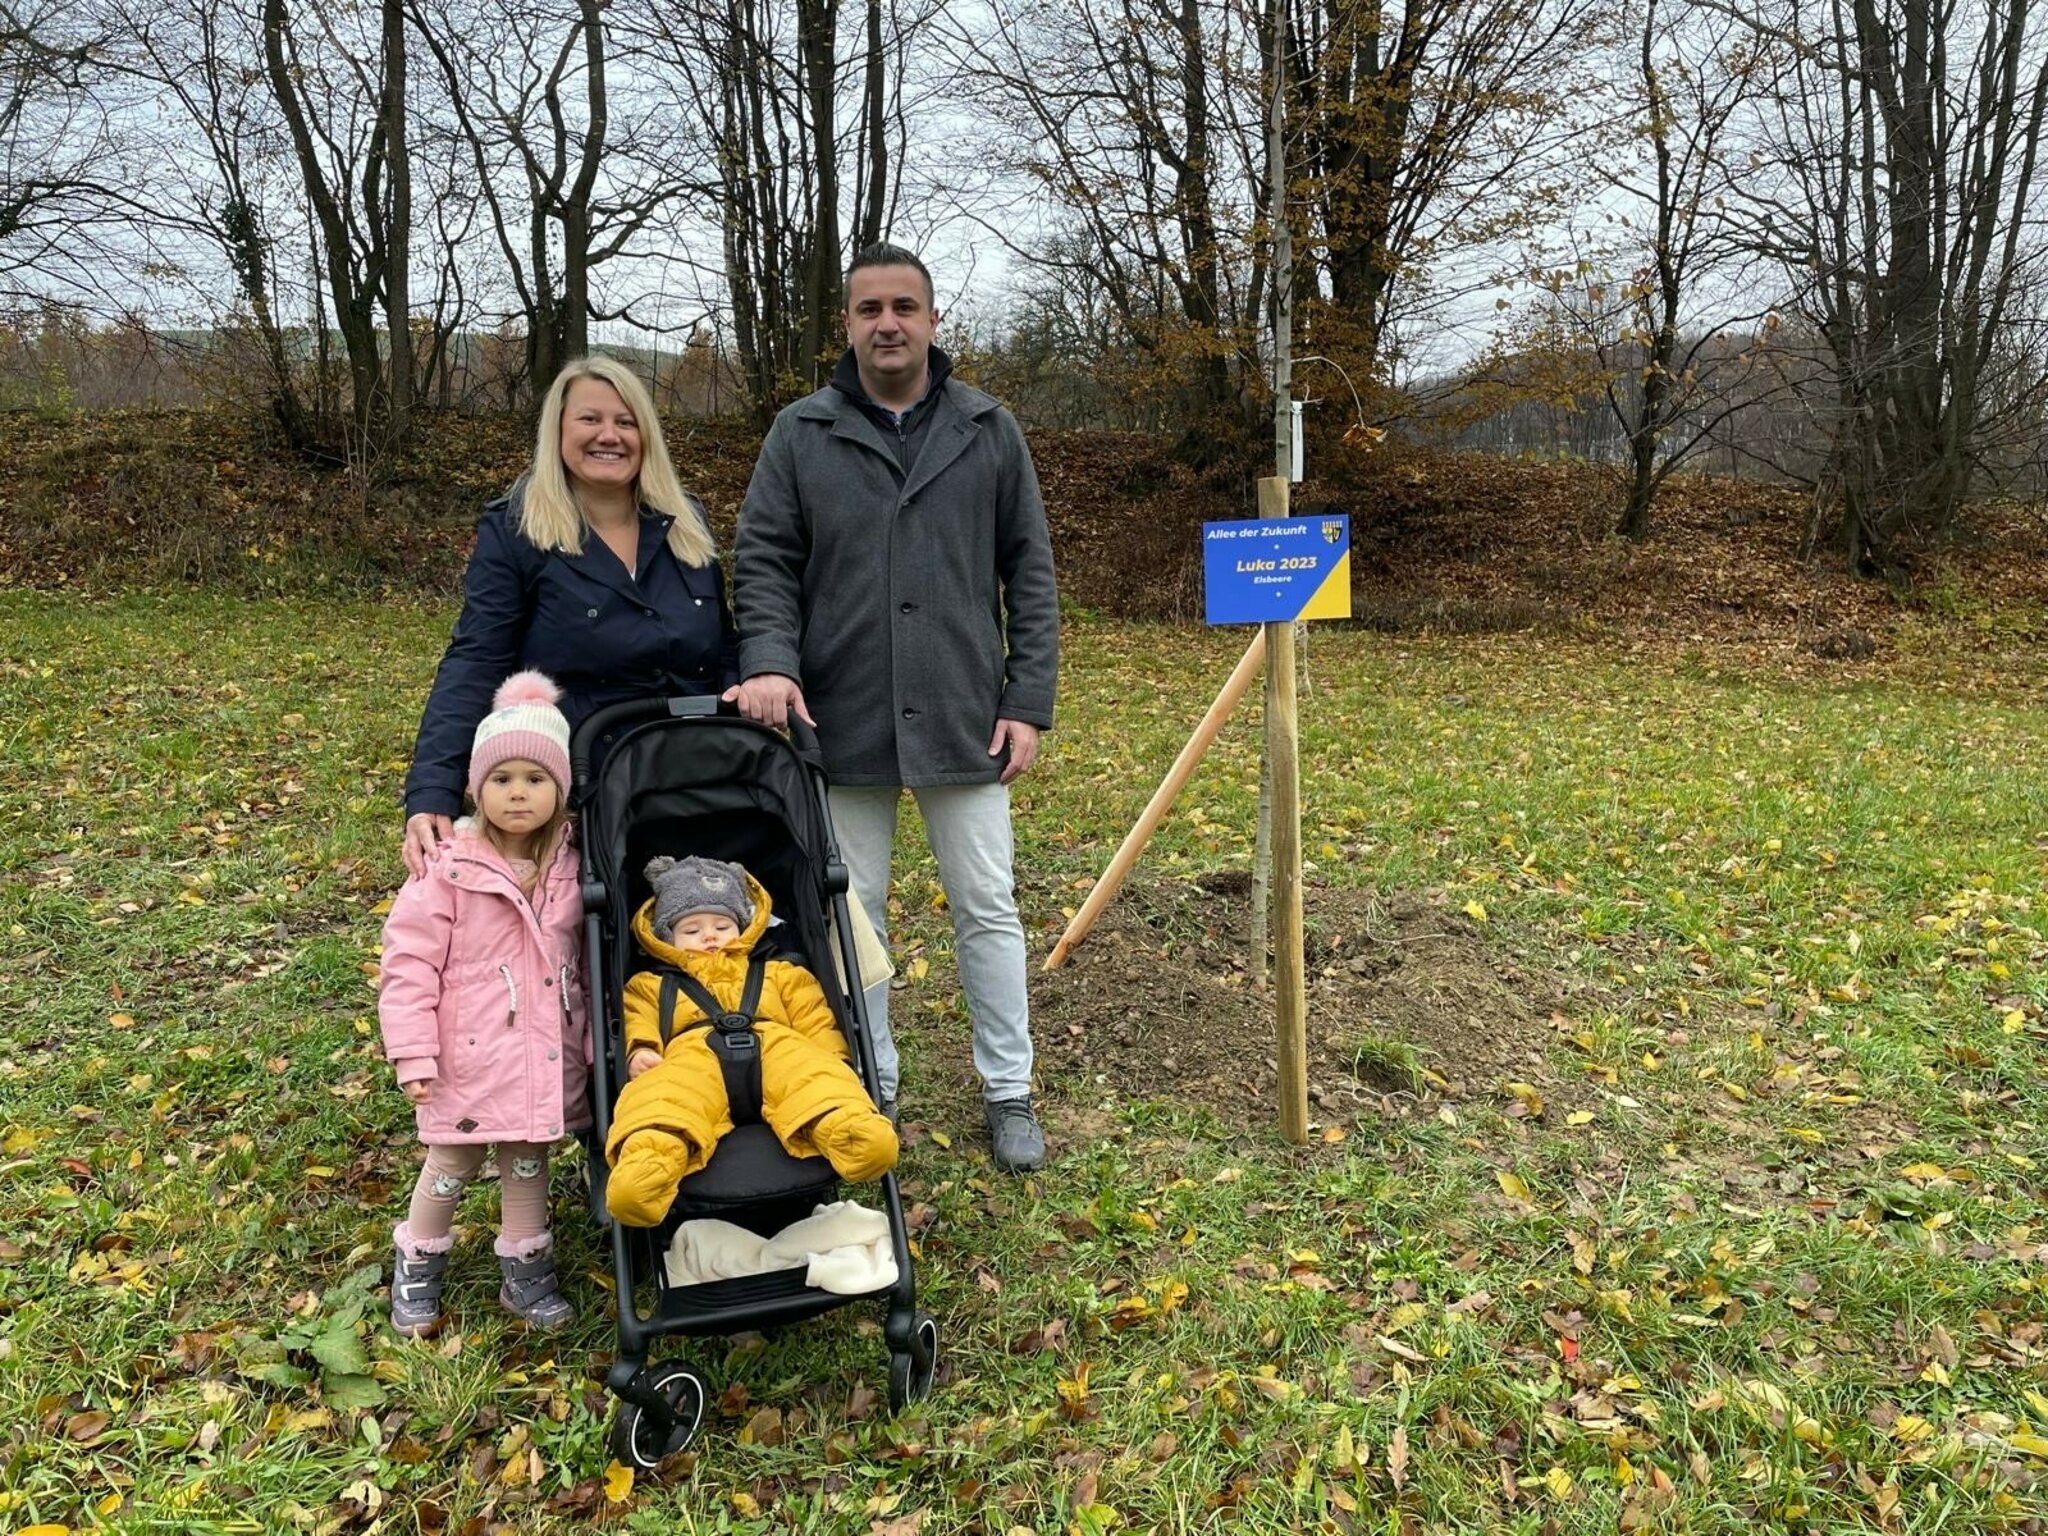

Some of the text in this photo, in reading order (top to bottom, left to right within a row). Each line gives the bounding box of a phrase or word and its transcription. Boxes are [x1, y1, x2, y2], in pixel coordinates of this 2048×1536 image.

[1207, 524, 1307, 540] Allee der Zukunft
[1236, 556, 1318, 573] Luka 2023
